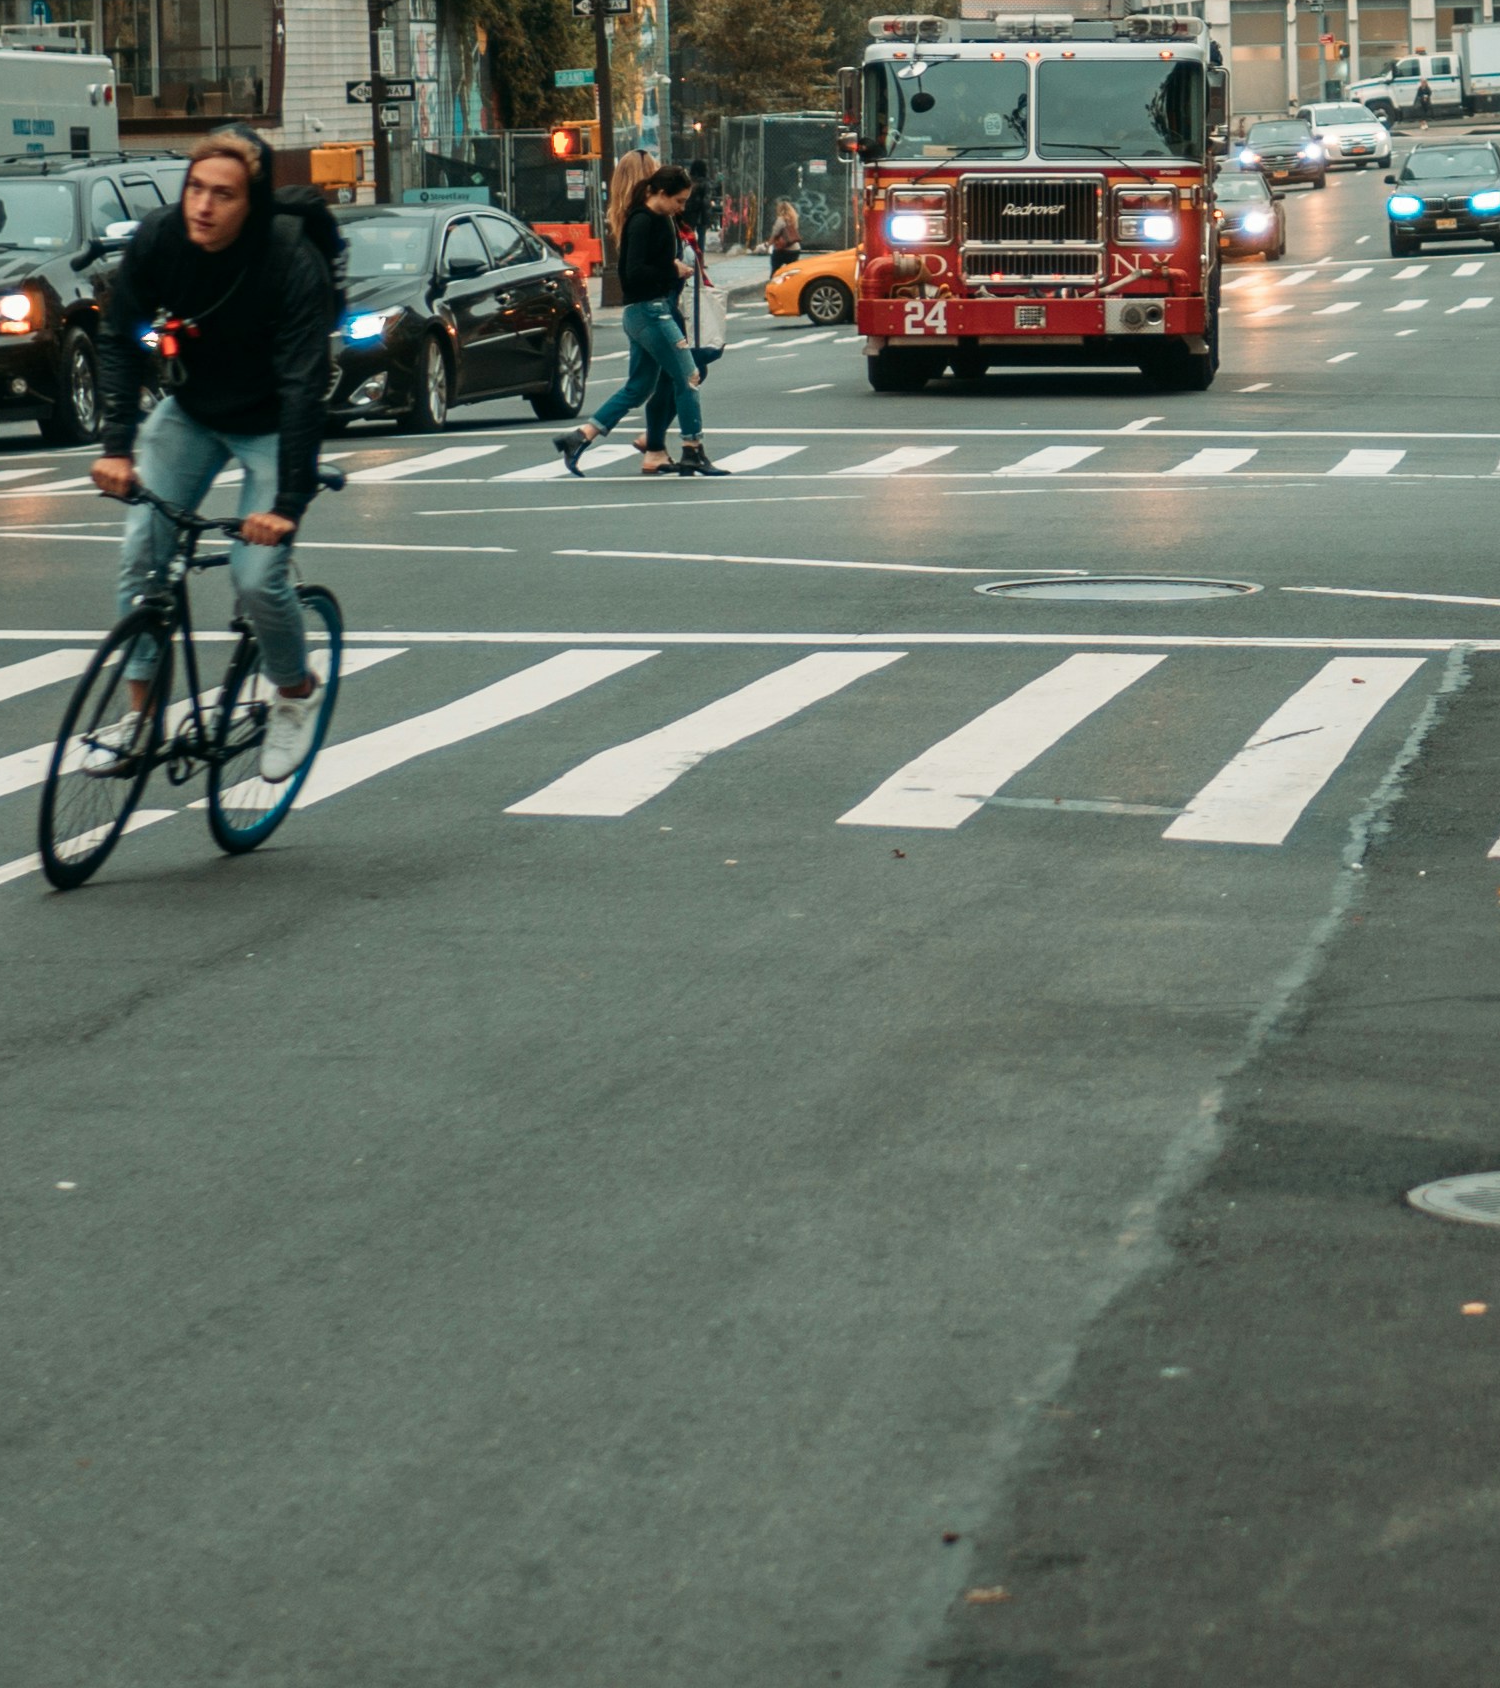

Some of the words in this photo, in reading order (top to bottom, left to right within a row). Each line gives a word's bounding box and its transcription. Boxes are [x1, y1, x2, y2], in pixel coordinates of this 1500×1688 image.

[430, 191, 470, 201] StreetEasy
[1002, 202, 1066, 217] Redrover
[904, 300, 948, 335] 24
